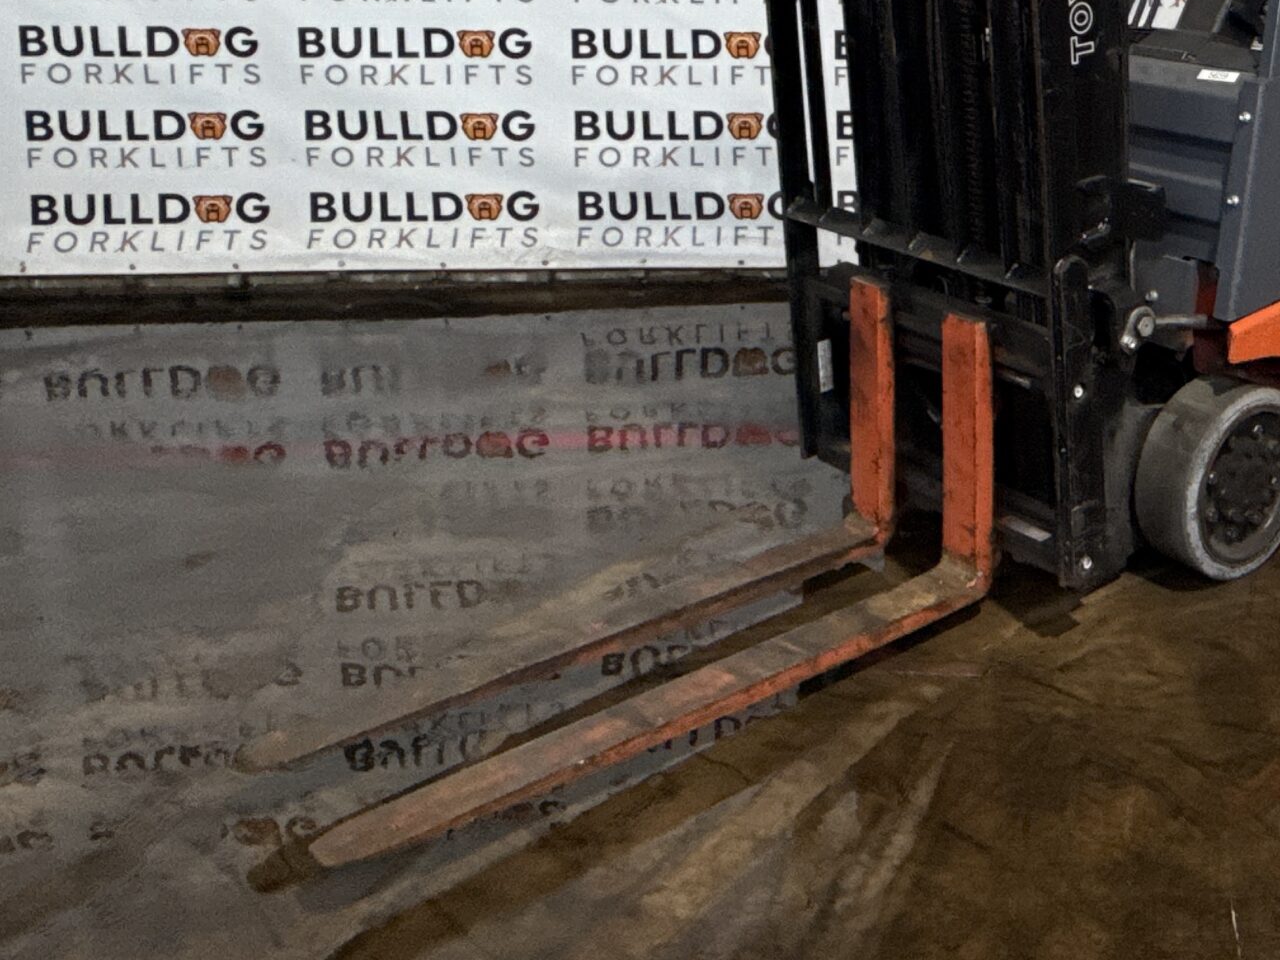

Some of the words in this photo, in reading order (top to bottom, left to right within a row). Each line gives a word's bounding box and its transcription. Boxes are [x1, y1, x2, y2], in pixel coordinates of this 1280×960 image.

[18, 25, 259, 58] BULLDG
[297, 27, 532, 60] BULLDG
[21, 63, 261, 85] FORKLIFTS
[300, 64, 532, 86] FORKLIFTS
[24, 109, 265, 142] BULLDG
[304, 109, 536, 142] BULLDG
[27, 146, 267, 169] FORKLIFTS
[306, 146, 535, 167] FORKLIFTS
[30, 192, 271, 226] BULLDG
[309, 190, 540, 223] BULLDG
[26, 229, 267, 253] FORKLIFTS
[307, 227, 538, 249] FORKLIFTS
